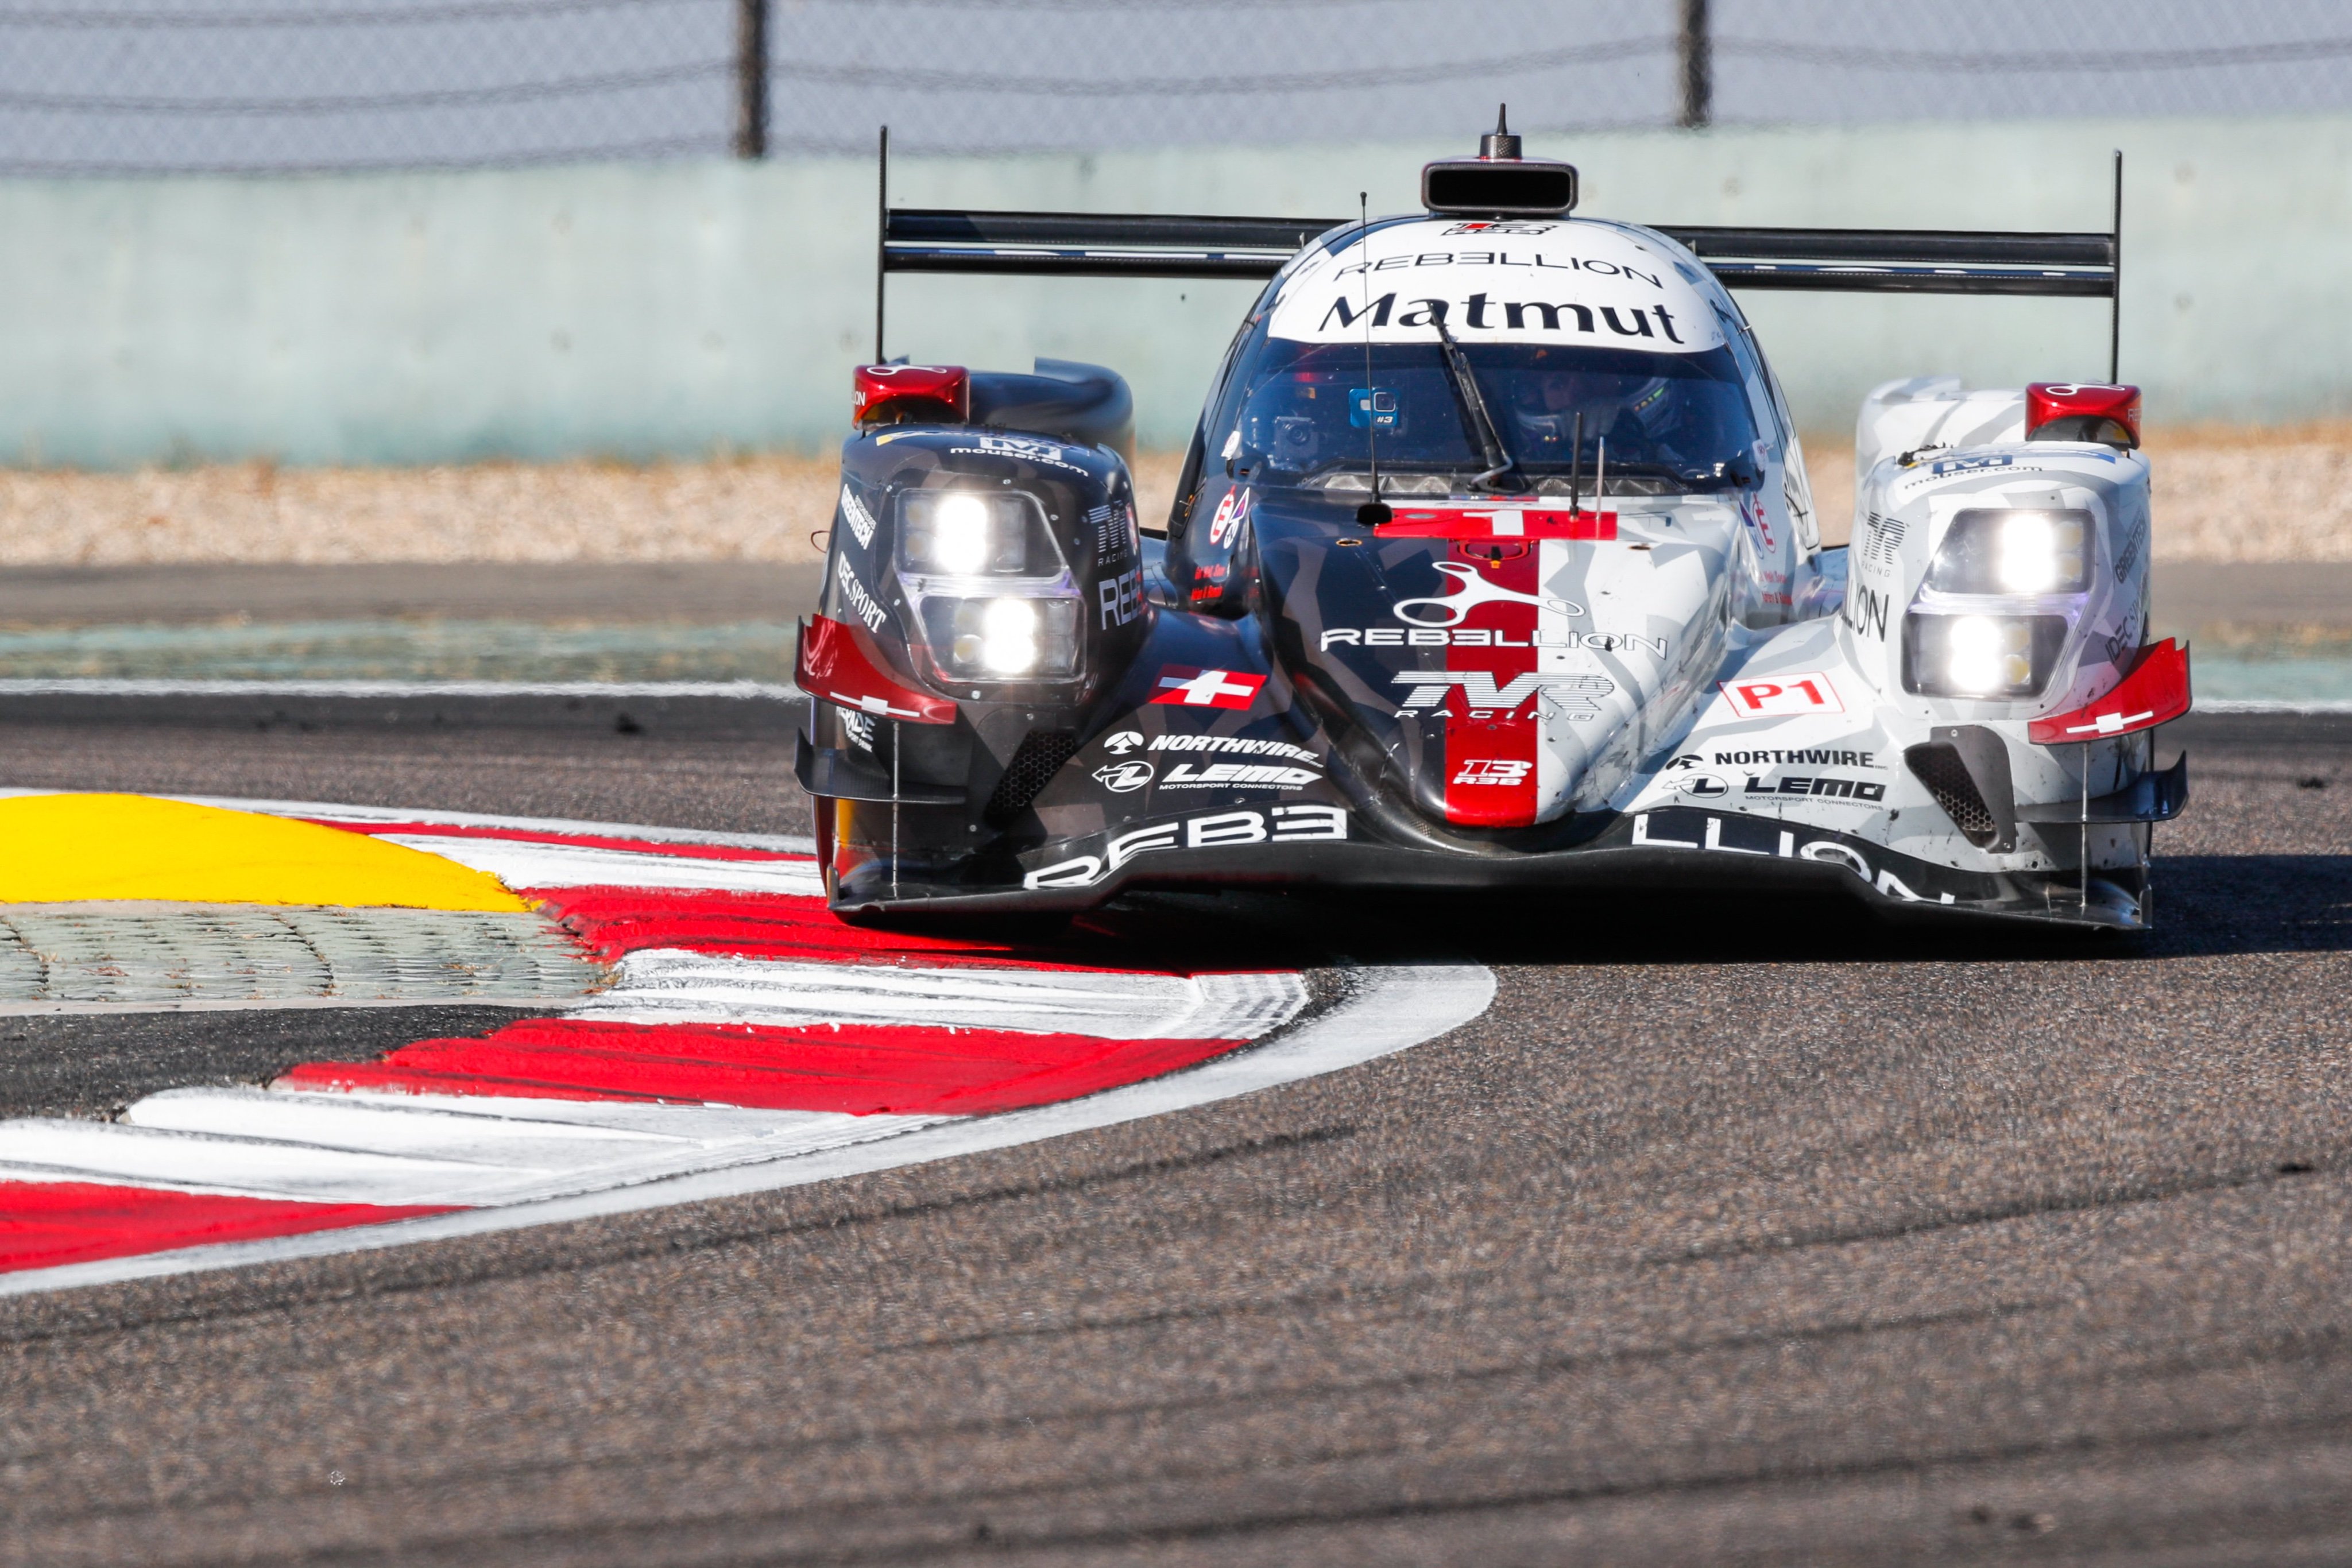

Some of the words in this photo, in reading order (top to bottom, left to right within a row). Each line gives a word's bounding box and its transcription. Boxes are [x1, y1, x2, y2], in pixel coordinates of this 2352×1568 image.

[1318, 292, 1685, 344] Matmut
[950, 447, 1089, 477] mouser.com
[1904, 464, 2043, 490] mouser.com
[849, 578, 887, 634] SPORT
[1735, 679, 1825, 710] P1
[1394, 710, 1595, 721] RACING
[1147, 734, 1320, 762] NORTHWIRE
[1715, 749, 1875, 768] NORTHWIRE
[1161, 764, 1323, 785] LEMO
[1232, 783, 1303, 791] CONNECTORS
[1743, 776, 1886, 802] LEMO
[1744, 795, 1814, 803] MOTORSPORT
[1817, 798, 1885, 812] CONNECTORS
